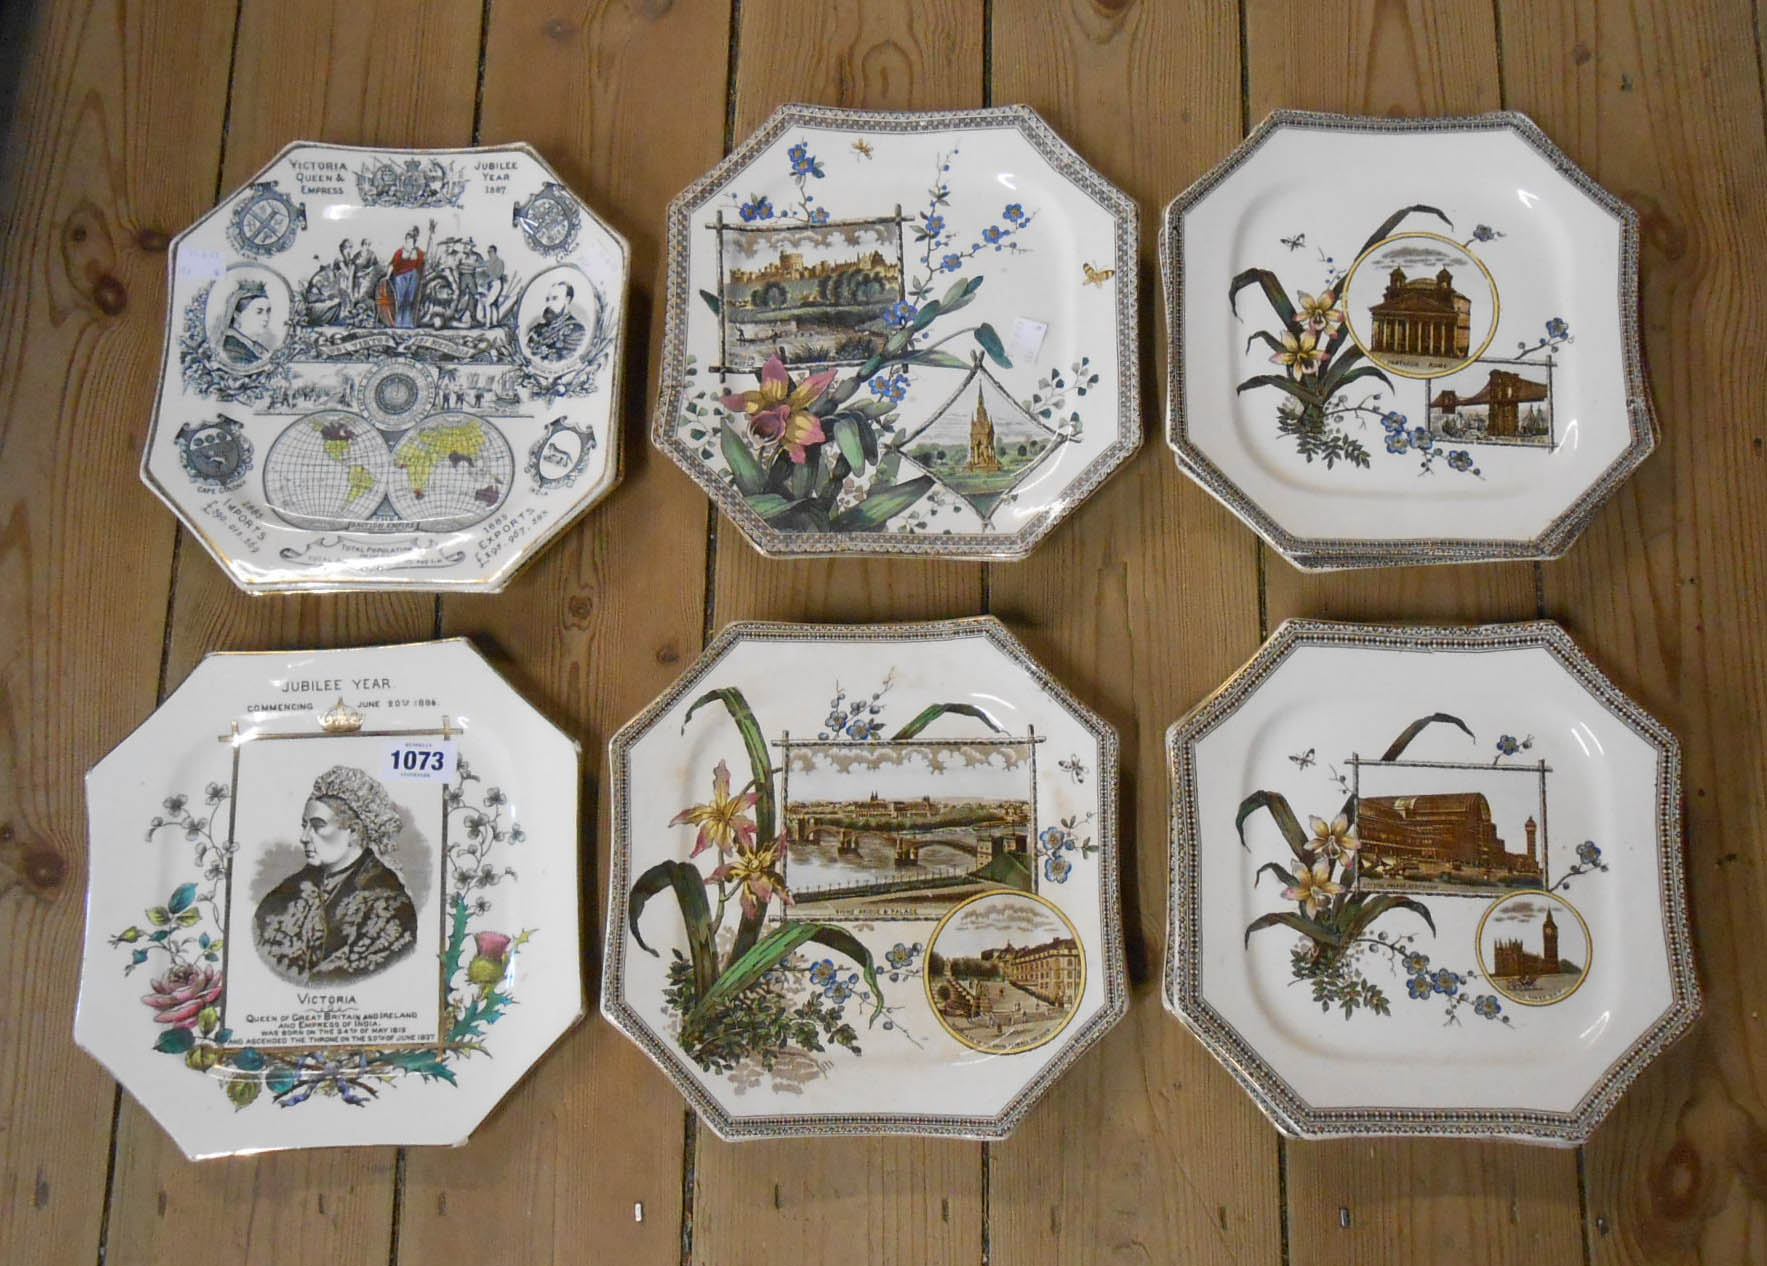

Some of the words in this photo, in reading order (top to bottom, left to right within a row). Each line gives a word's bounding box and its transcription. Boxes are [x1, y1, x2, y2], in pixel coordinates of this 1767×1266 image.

[289, 159, 348, 171] VICTORIA
[474, 160, 518, 170] JUBILEE
[296, 173, 332, 182] QUEEN
[335, 174, 345, 182] &
[482, 172, 510, 182] YEAR
[300, 185, 344, 195] EMPRESS
[223, 498, 266, 541] IMPORTS
[478, 508, 536, 550] EXPORTS
[282, 680, 342, 693] JUBILEE
[352, 678, 391, 690] YEAR
[247, 702, 314, 712] COMMENCING
[357, 700, 380, 708] JUNE
[391, 750, 444, 770] 1073
[297, 993, 357, 1004] VICTORIA
[246, 1014, 278, 1023] QUEEN
[292, 1013, 322, 1022] GREAT
[324, 1012, 361, 1021] BRITAIN
[380, 1012, 418, 1020] IRELAND
[298, 1020, 340, 1028] EMPRESS
